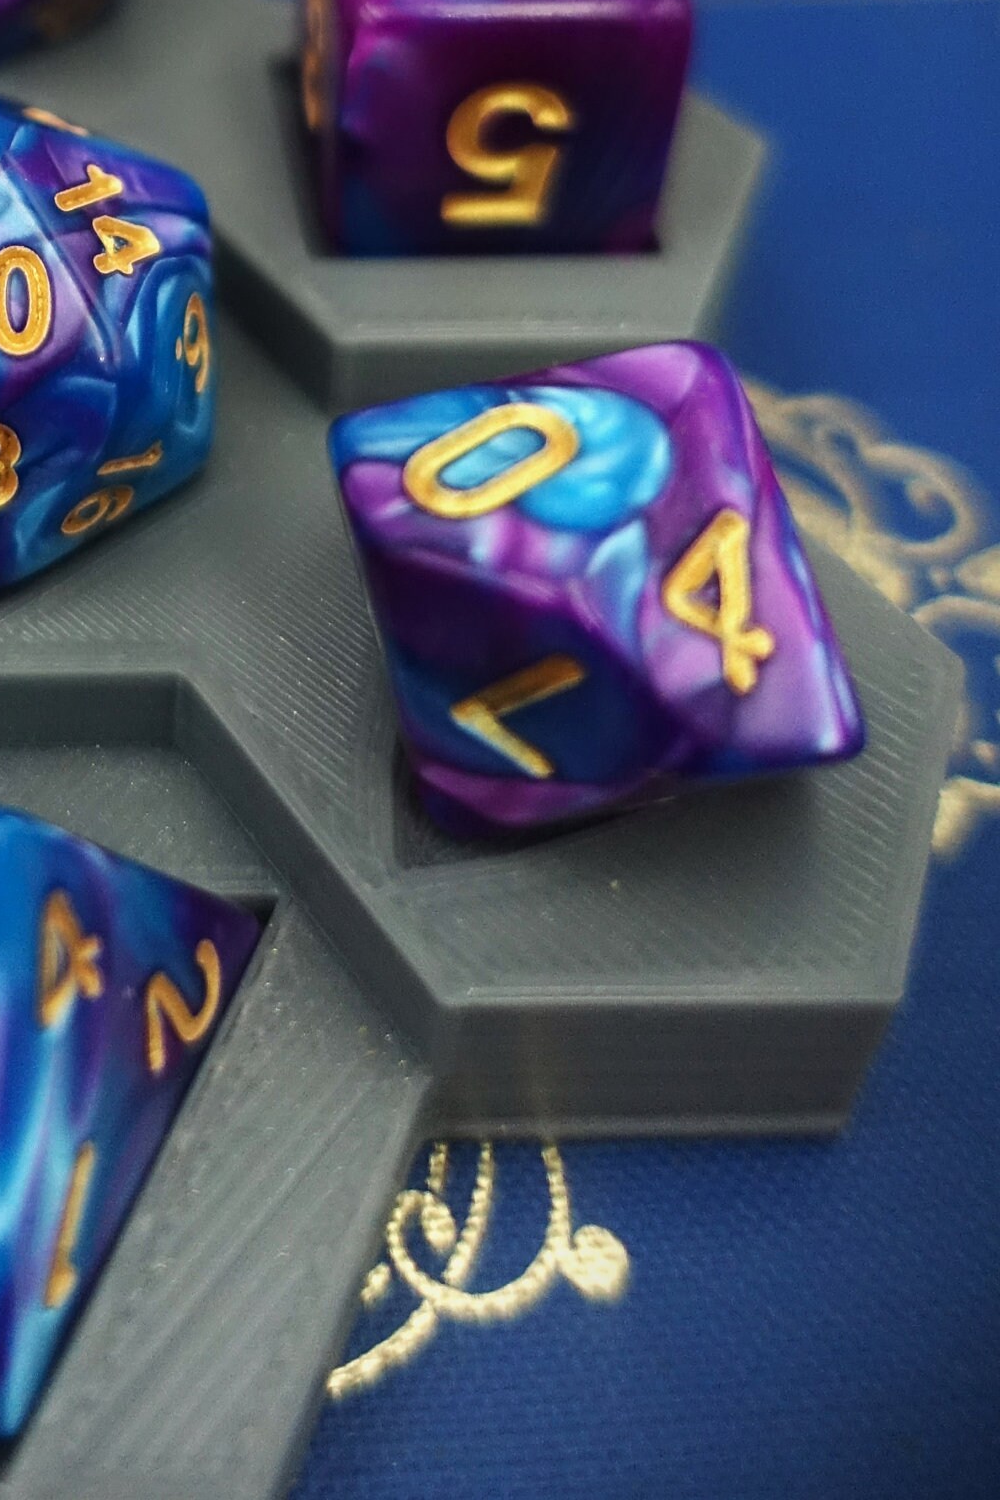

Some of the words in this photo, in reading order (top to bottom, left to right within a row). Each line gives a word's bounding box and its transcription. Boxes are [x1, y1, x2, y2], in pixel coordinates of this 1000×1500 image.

[54, 163, 160, 275] 14
[440, 82, 574, 228] 5
[402, 402, 579, 518] 0
[663, 508, 774, 696] 4
[37, 890, 102, 1028] 4
[146, 940, 220, 1072] 2
[43, 1141, 94, 1309] 1
